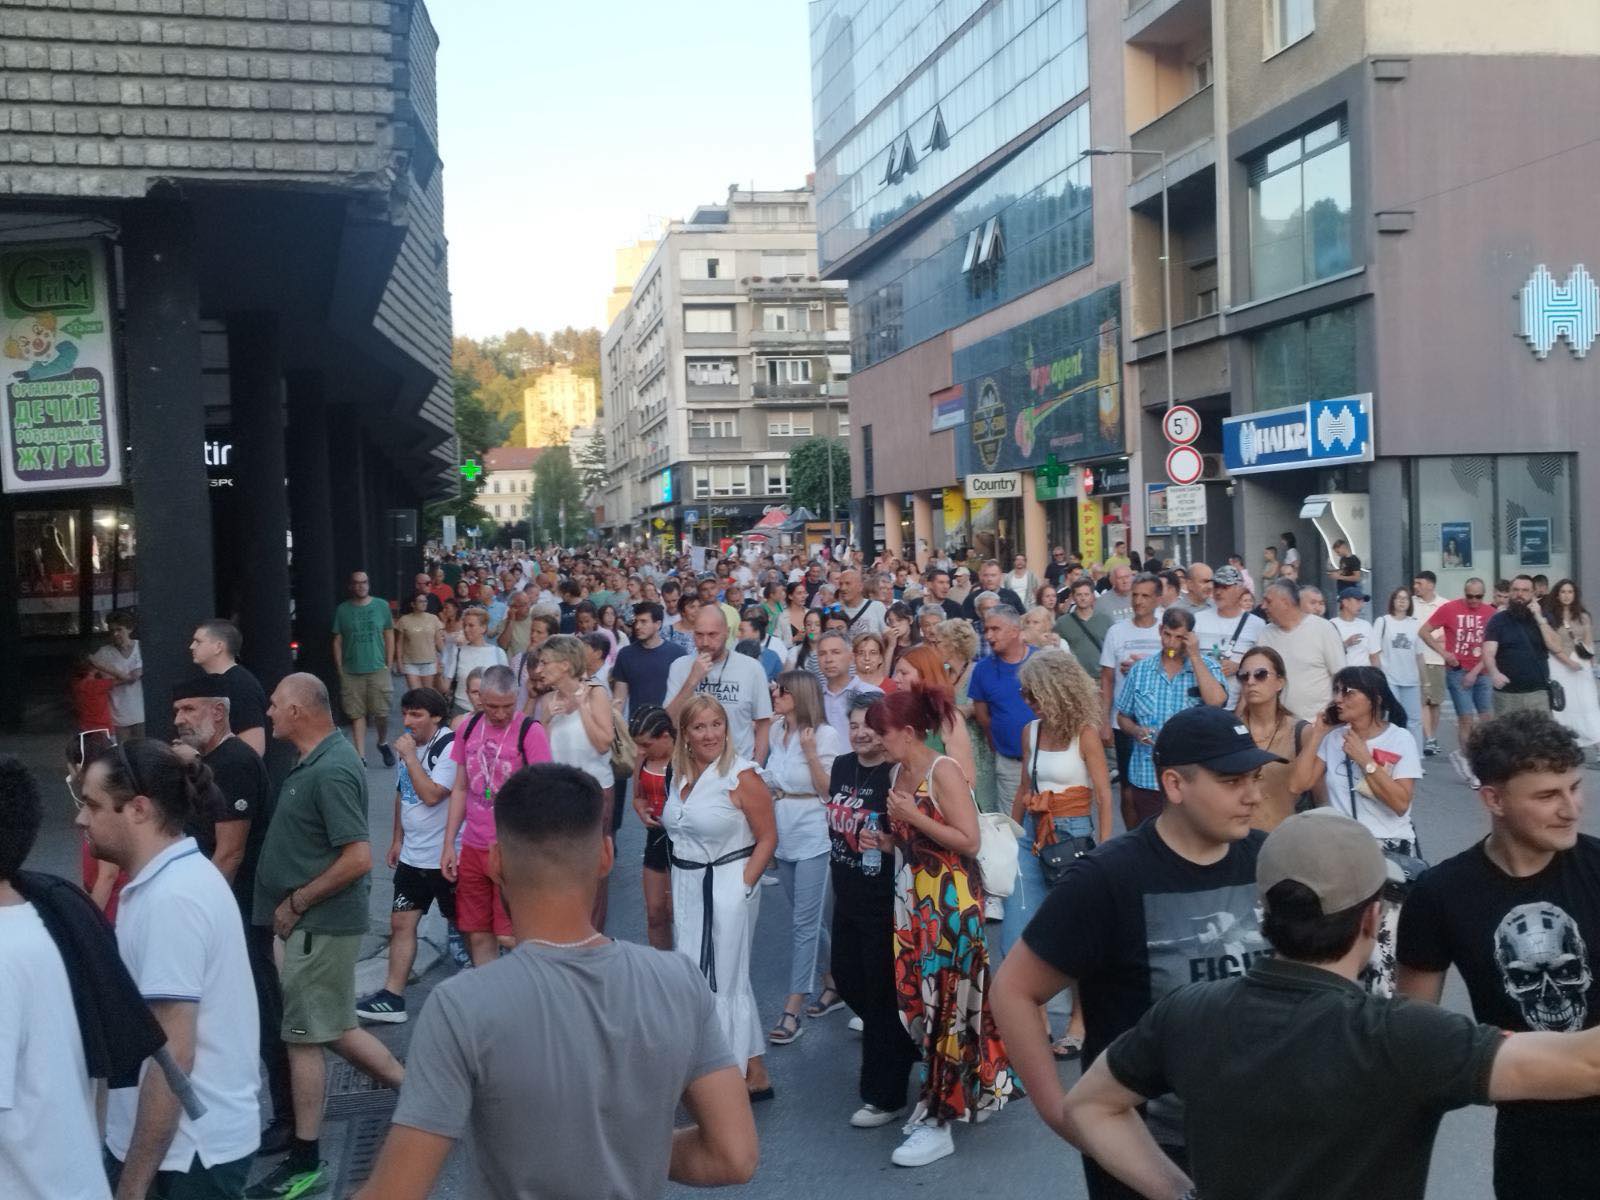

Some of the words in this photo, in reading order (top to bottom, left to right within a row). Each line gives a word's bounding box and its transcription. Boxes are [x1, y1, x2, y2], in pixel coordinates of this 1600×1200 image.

[15, 397, 101, 428] ДЕЧИЈЕ
[17, 442, 105, 470] ЖУРКЕ
[973, 477, 1016, 491] Country
[695, 682, 740, 693] RTIZAN
